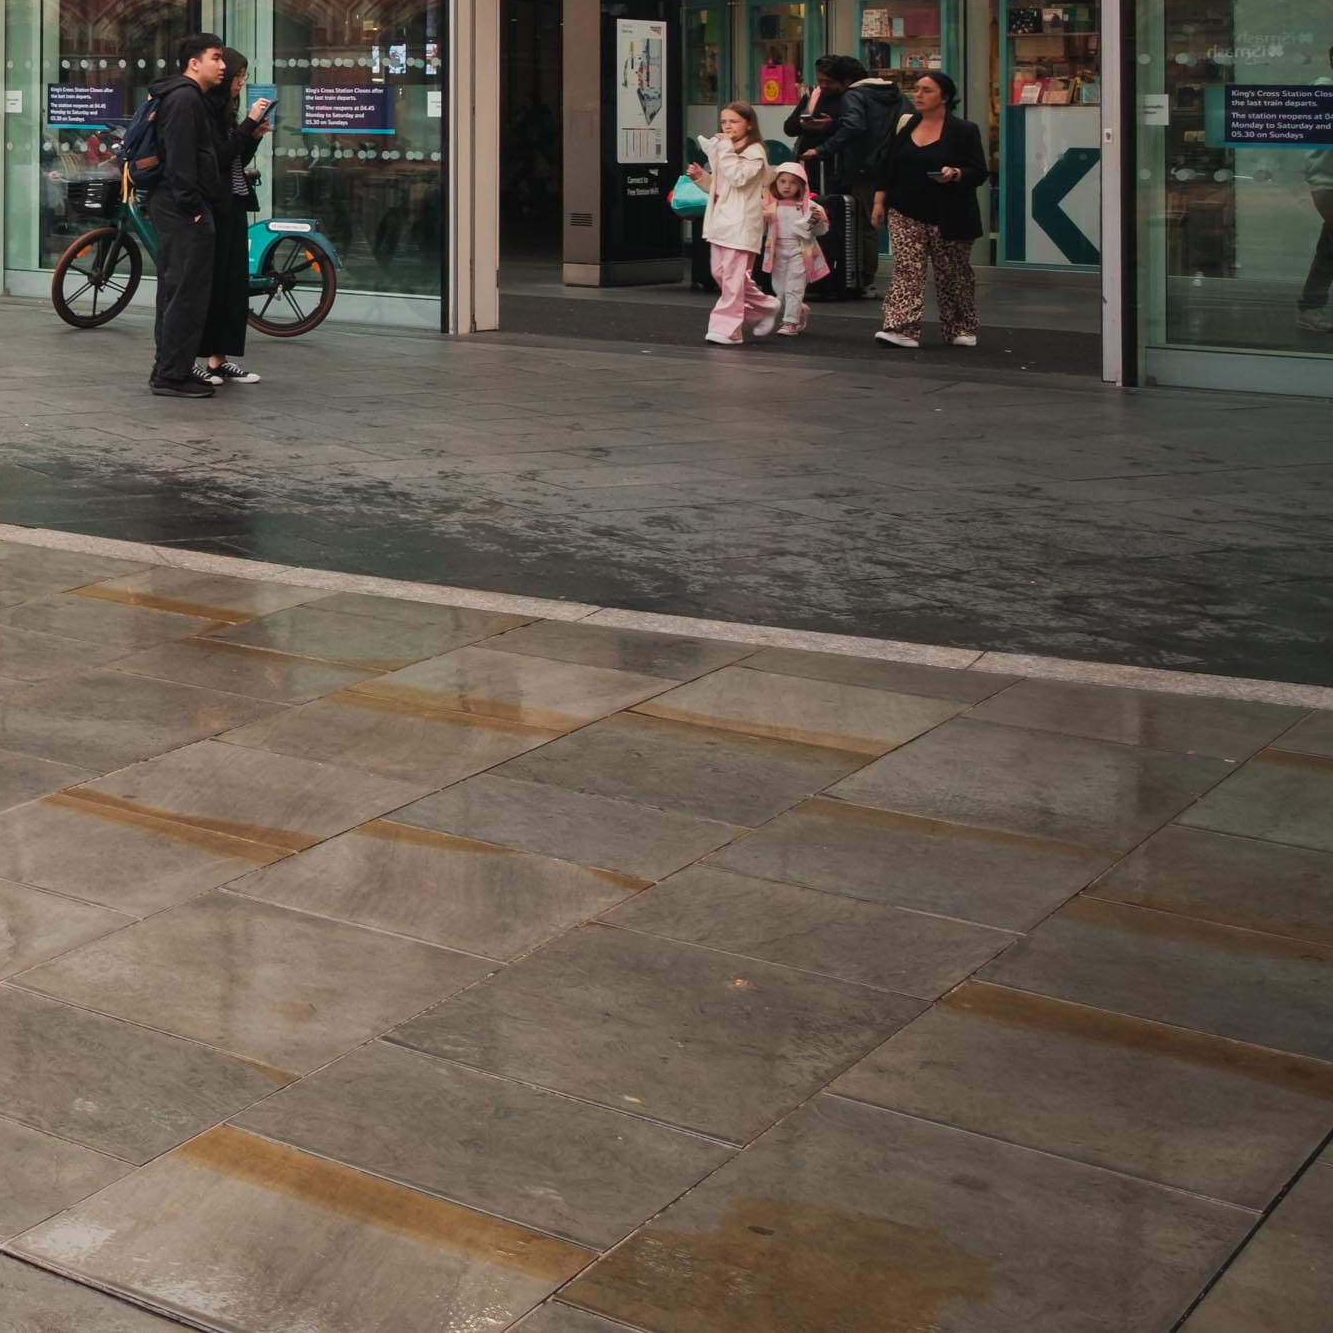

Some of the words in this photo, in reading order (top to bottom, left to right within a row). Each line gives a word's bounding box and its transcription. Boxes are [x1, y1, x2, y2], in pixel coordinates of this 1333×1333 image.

[1231, 90, 1255, 98] King's
[1231, 122, 1264, 130] Monday
[1277, 123, 1313, 131] Saturday
[1269, 132, 1304, 140] Sundays
